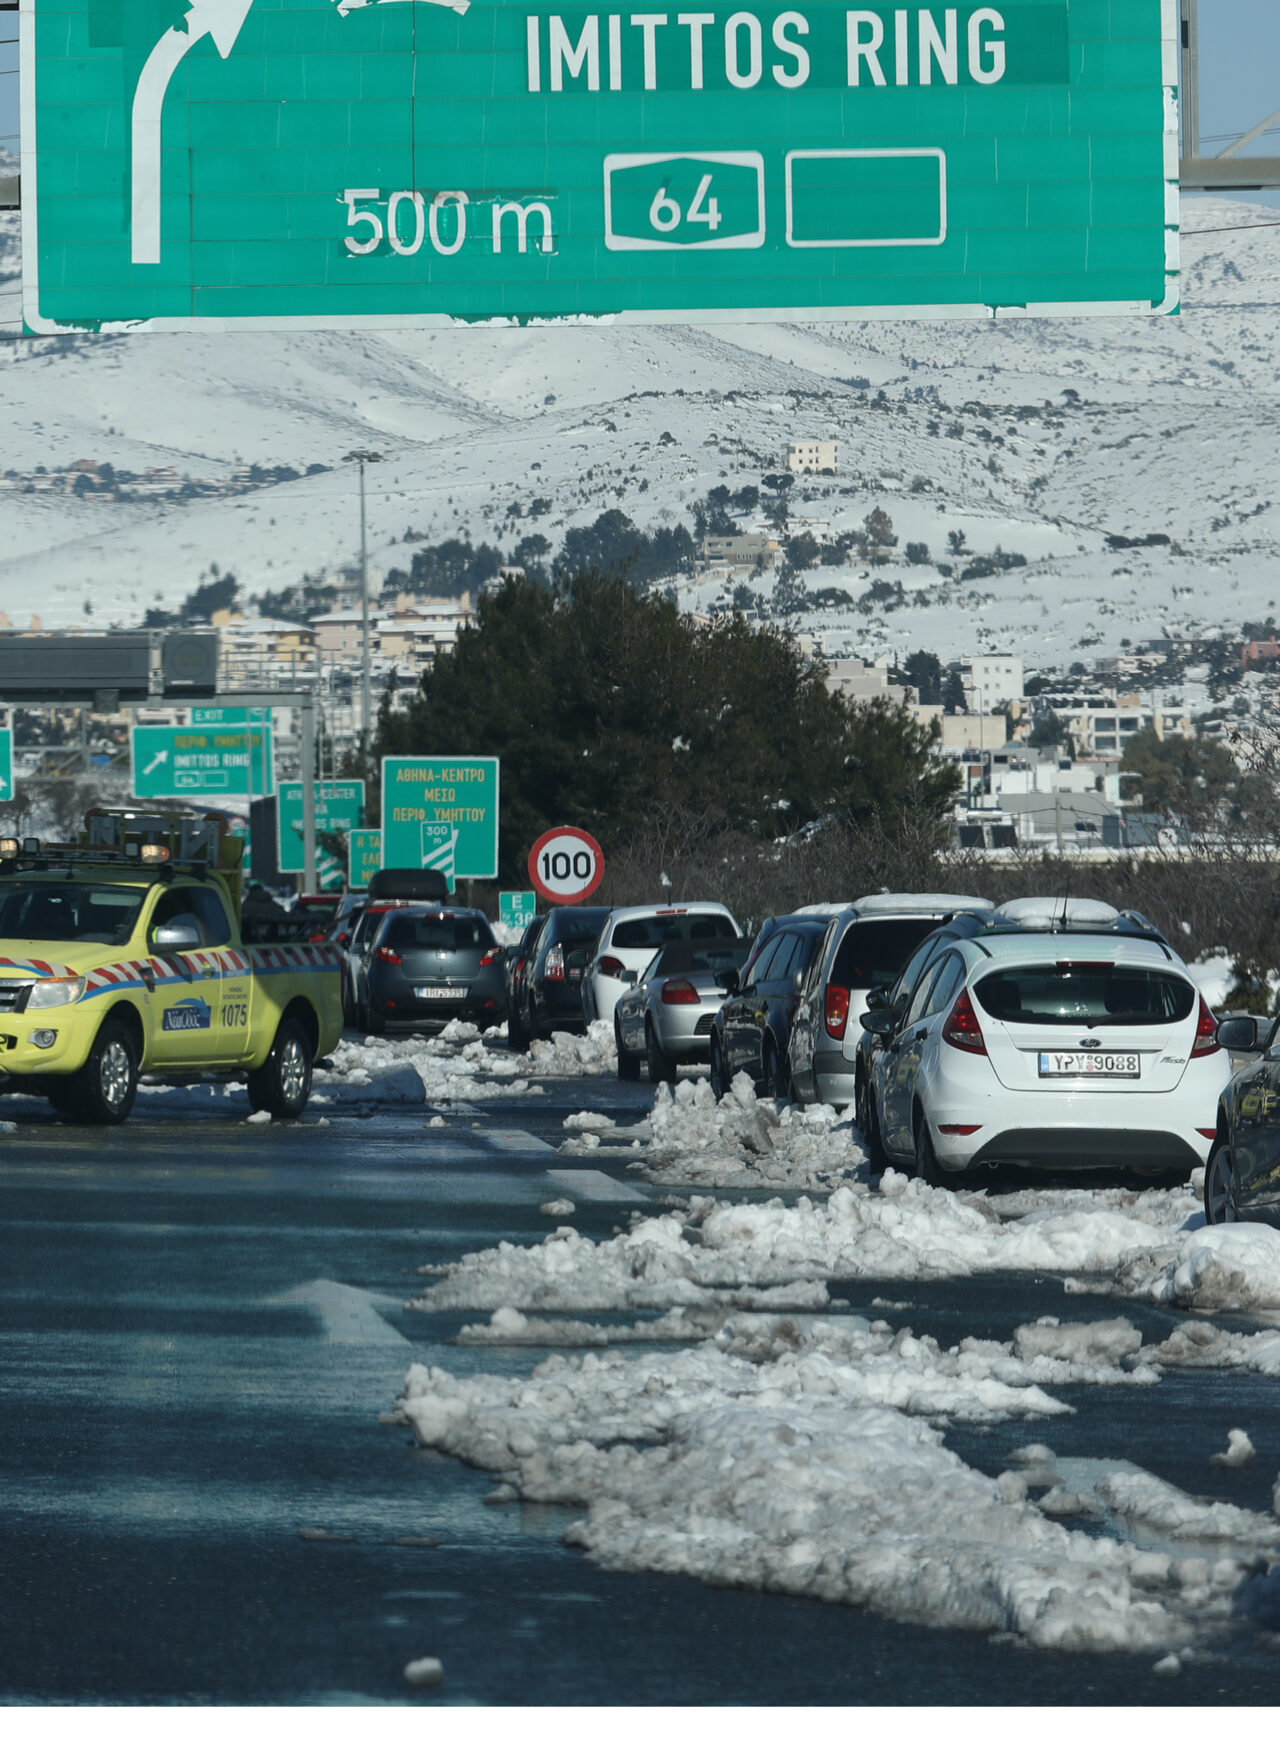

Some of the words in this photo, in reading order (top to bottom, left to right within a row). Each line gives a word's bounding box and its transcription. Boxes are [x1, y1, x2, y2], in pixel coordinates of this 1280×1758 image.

[527, 9, 810, 92] IMITTOS
[846, 7, 1007, 86] RING
[648, 174, 721, 232] 64
[342, 189, 467, 256] 500
[494, 190, 556, 255] m
[195, 709, 224, 721] EXIT
[396, 767, 486, 783] ΑΘΗΝΑ-ΚΕΝΤΡΟ
[424, 788, 456, 802] ΜΕΣΩ
[434, 807, 486, 822] ΥΜΗΤΤΟΥ
[426, 825, 449, 836] 300
[542, 851, 592, 880] 100
[511, 894, 523, 909] E
[221, 1003, 248, 1027] 1075
